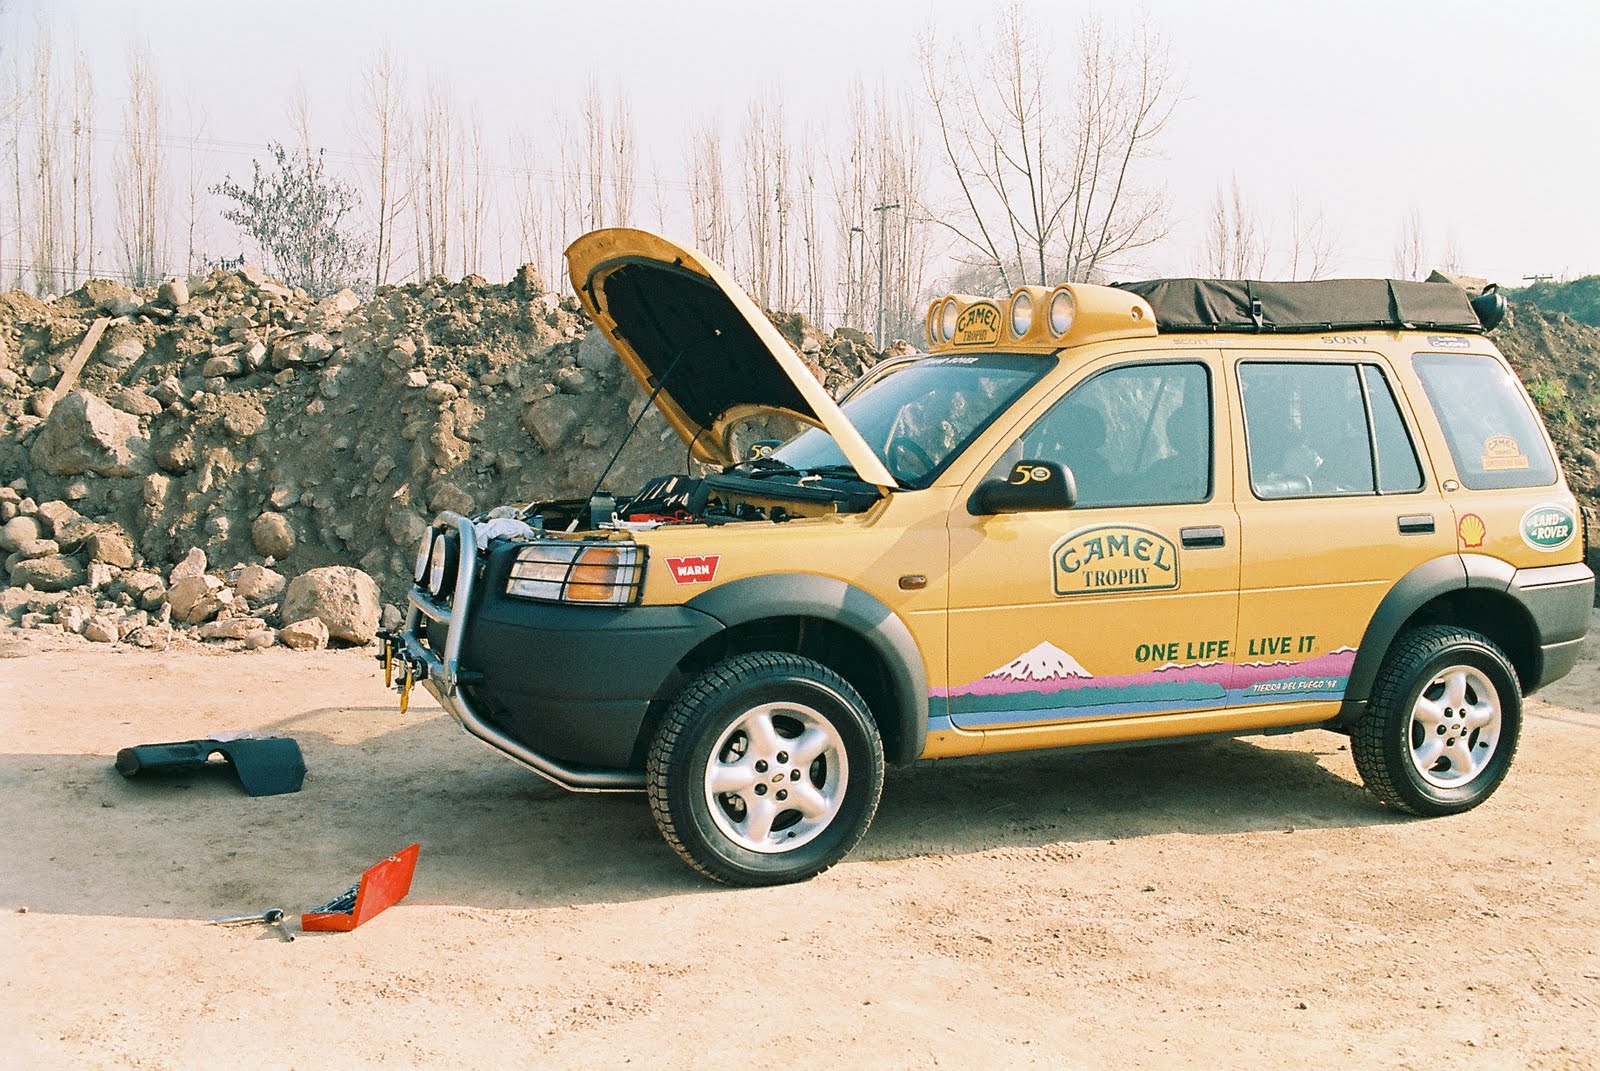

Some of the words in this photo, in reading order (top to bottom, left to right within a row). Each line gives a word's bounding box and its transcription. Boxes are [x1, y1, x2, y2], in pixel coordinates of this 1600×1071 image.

[957, 308, 997, 333] CAMEL
[1322, 335, 1369, 345] SONY
[1010, 465, 1051, 485] 50
[1533, 513, 1559, 527] LAND
[1536, 525, 1568, 540] ROVER
[1060, 534, 1171, 573] CAMEL
[677, 565, 710, 576] WARN
[1083, 567, 1149, 587] TROPHY
[1135, 642, 1180, 662] ONE
[1249, 636, 1292, 656] LIVE
[1253, 683, 1282, 692] TIERRA
[1283, 682, 1297, 690] DEL
[1298, 681, 1324, 689] FUEGO
